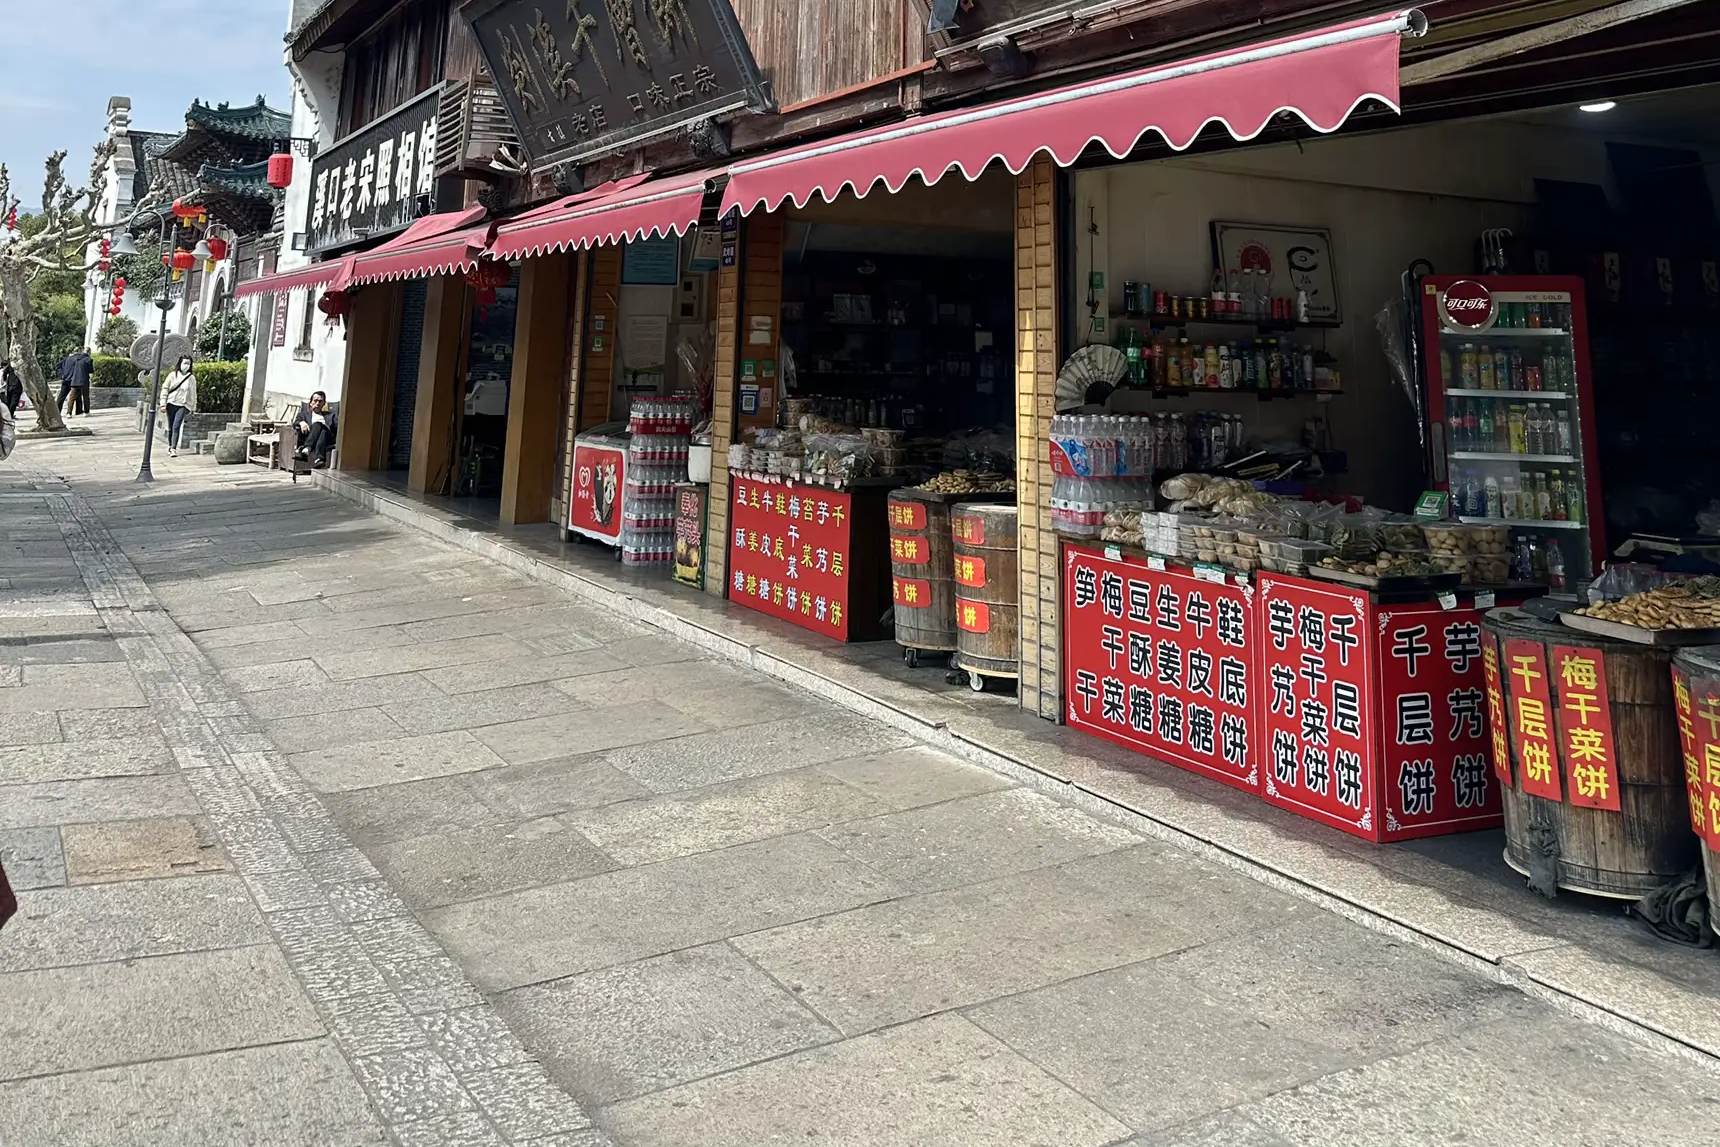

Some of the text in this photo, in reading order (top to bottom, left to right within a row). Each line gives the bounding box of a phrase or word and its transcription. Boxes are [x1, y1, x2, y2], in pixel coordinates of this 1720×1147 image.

[627, 64, 720, 112] 口味正宗
[312, 115, 437, 230] 溪口老宋照相馆
[1447, 297, 1488, 310] 可口可乐
[734, 486, 748, 592] 豆酥糖
[746, 487, 760, 596] 生姜糖
[759, 490, 774, 600] 牛皮糖
[786, 495, 801, 611] 梅干菜饼
[800, 497, 815, 616] 苔菜饼
[814, 501, 830, 621] 芋艿饼
[830, 504, 845, 627] 千层饼
[1074, 567, 1099, 713] 笋干
[1101, 570, 1125, 724] 梅干菜
[1128, 580, 1153, 733] 豆酥糖
[1156, 584, 1183, 745] 生姜糖
[1186, 592, 1214, 755] 牛皮糖
[1217, 598, 1248, 767] 鞋底饼
[1268, 599, 1298, 786] 芋艿饼
[1299, 606, 1330, 796] 梅干菜饼
[1329, 614, 1361, 810] 千层饼
[1483, 644, 1507, 771] 芋艿饼
[1392, 624, 1436, 815] 千层饼
[1444, 621, 1487, 808] 芋艿饼
[1512, 655, 1552, 784] 千层饼
[1561, 654, 1610, 800] 梅干菜饼
[1674, 675, 1706, 832] 梅干菜饼
